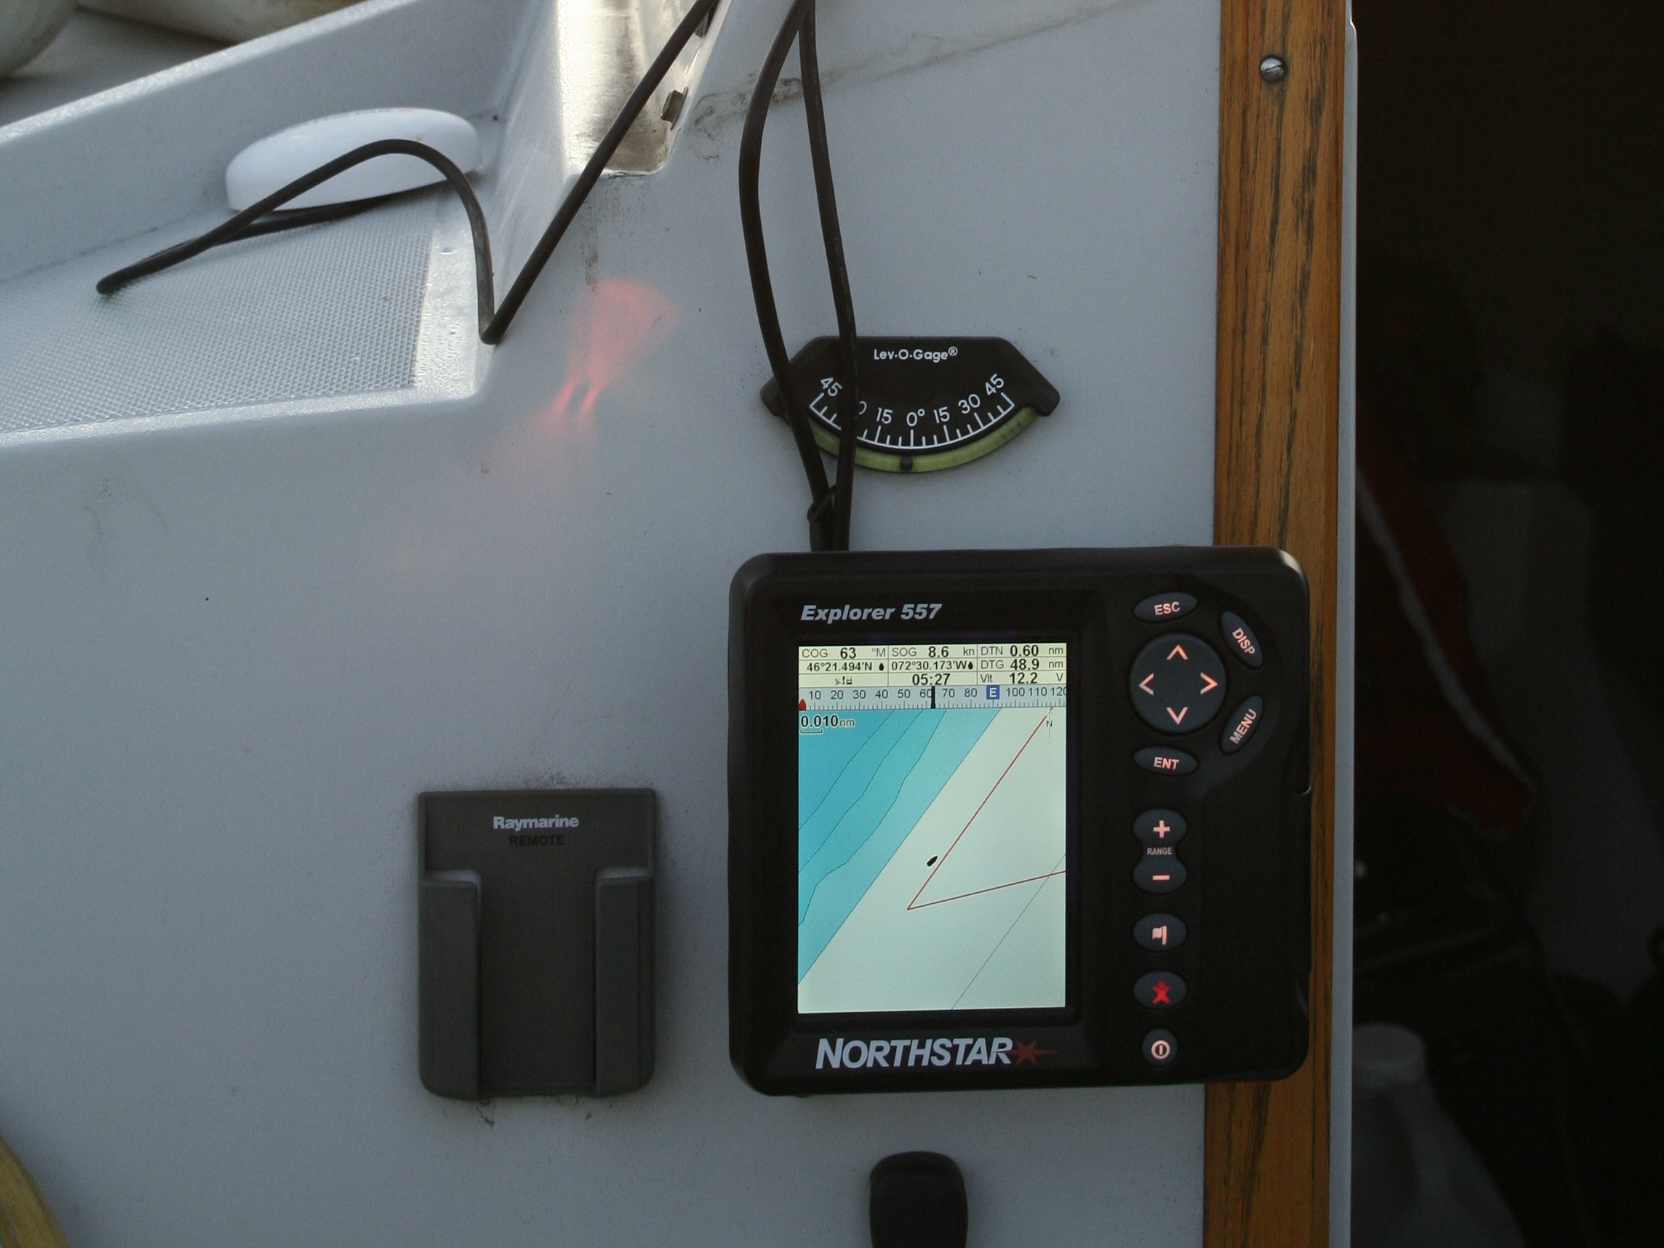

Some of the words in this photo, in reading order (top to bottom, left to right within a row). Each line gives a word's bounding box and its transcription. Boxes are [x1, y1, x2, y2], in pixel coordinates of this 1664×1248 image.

[820, 376, 843, 397] 45
[876, 407, 893, 425] 15
[933, 406, 950, 424] 15
[958, 393, 981, 414] 30
[984, 373, 1005, 397] 45
[800, 604, 896, 625] Explorer
[900, 603, 942, 620] 557
[1154, 601, 1181, 616] ESC
[1232, 627, 1256, 655] DISP
[801, 648, 829, 659] COG
[840, 647, 857, 659] 63
[891, 647, 918, 657] SOG
[928, 645, 949, 658] 8.6
[963, 646, 975, 656] kn
[980, 646, 1003, 656] DTN
[1009, 644, 1039, 657] 0.60
[1048, 647, 1064, 655] nm
[980, 660, 1004, 669] DTG
[1010, 658, 1040, 671] 48.9
[911, 673, 951, 686] 05:27
[1009, 672, 1038, 684] 12.2
[1056, 672, 1064, 682] V
[808, 690, 822, 700] 10
[830, 690, 844, 700] 20
[852, 690, 866, 700] 30
[875, 689, 889, 699] 40
[897, 689, 911, 699] 50
[919, 689, 932, 699] 60
[942, 688, 956, 698] 70
[964, 688, 978, 698] 80
[1006, 687, 1026, 697] 100
[1028, 687, 1048, 697] 110
[1229, 708, 1258, 744] MENU
[1153, 756, 1180, 770] ENT
[492, 814, 580, 832] Raymarine
[509, 835, 565, 847] REMOTE
[1147, 846, 1173, 856] RANGE
[815, 1037, 1013, 1070] NORTHSTAR
